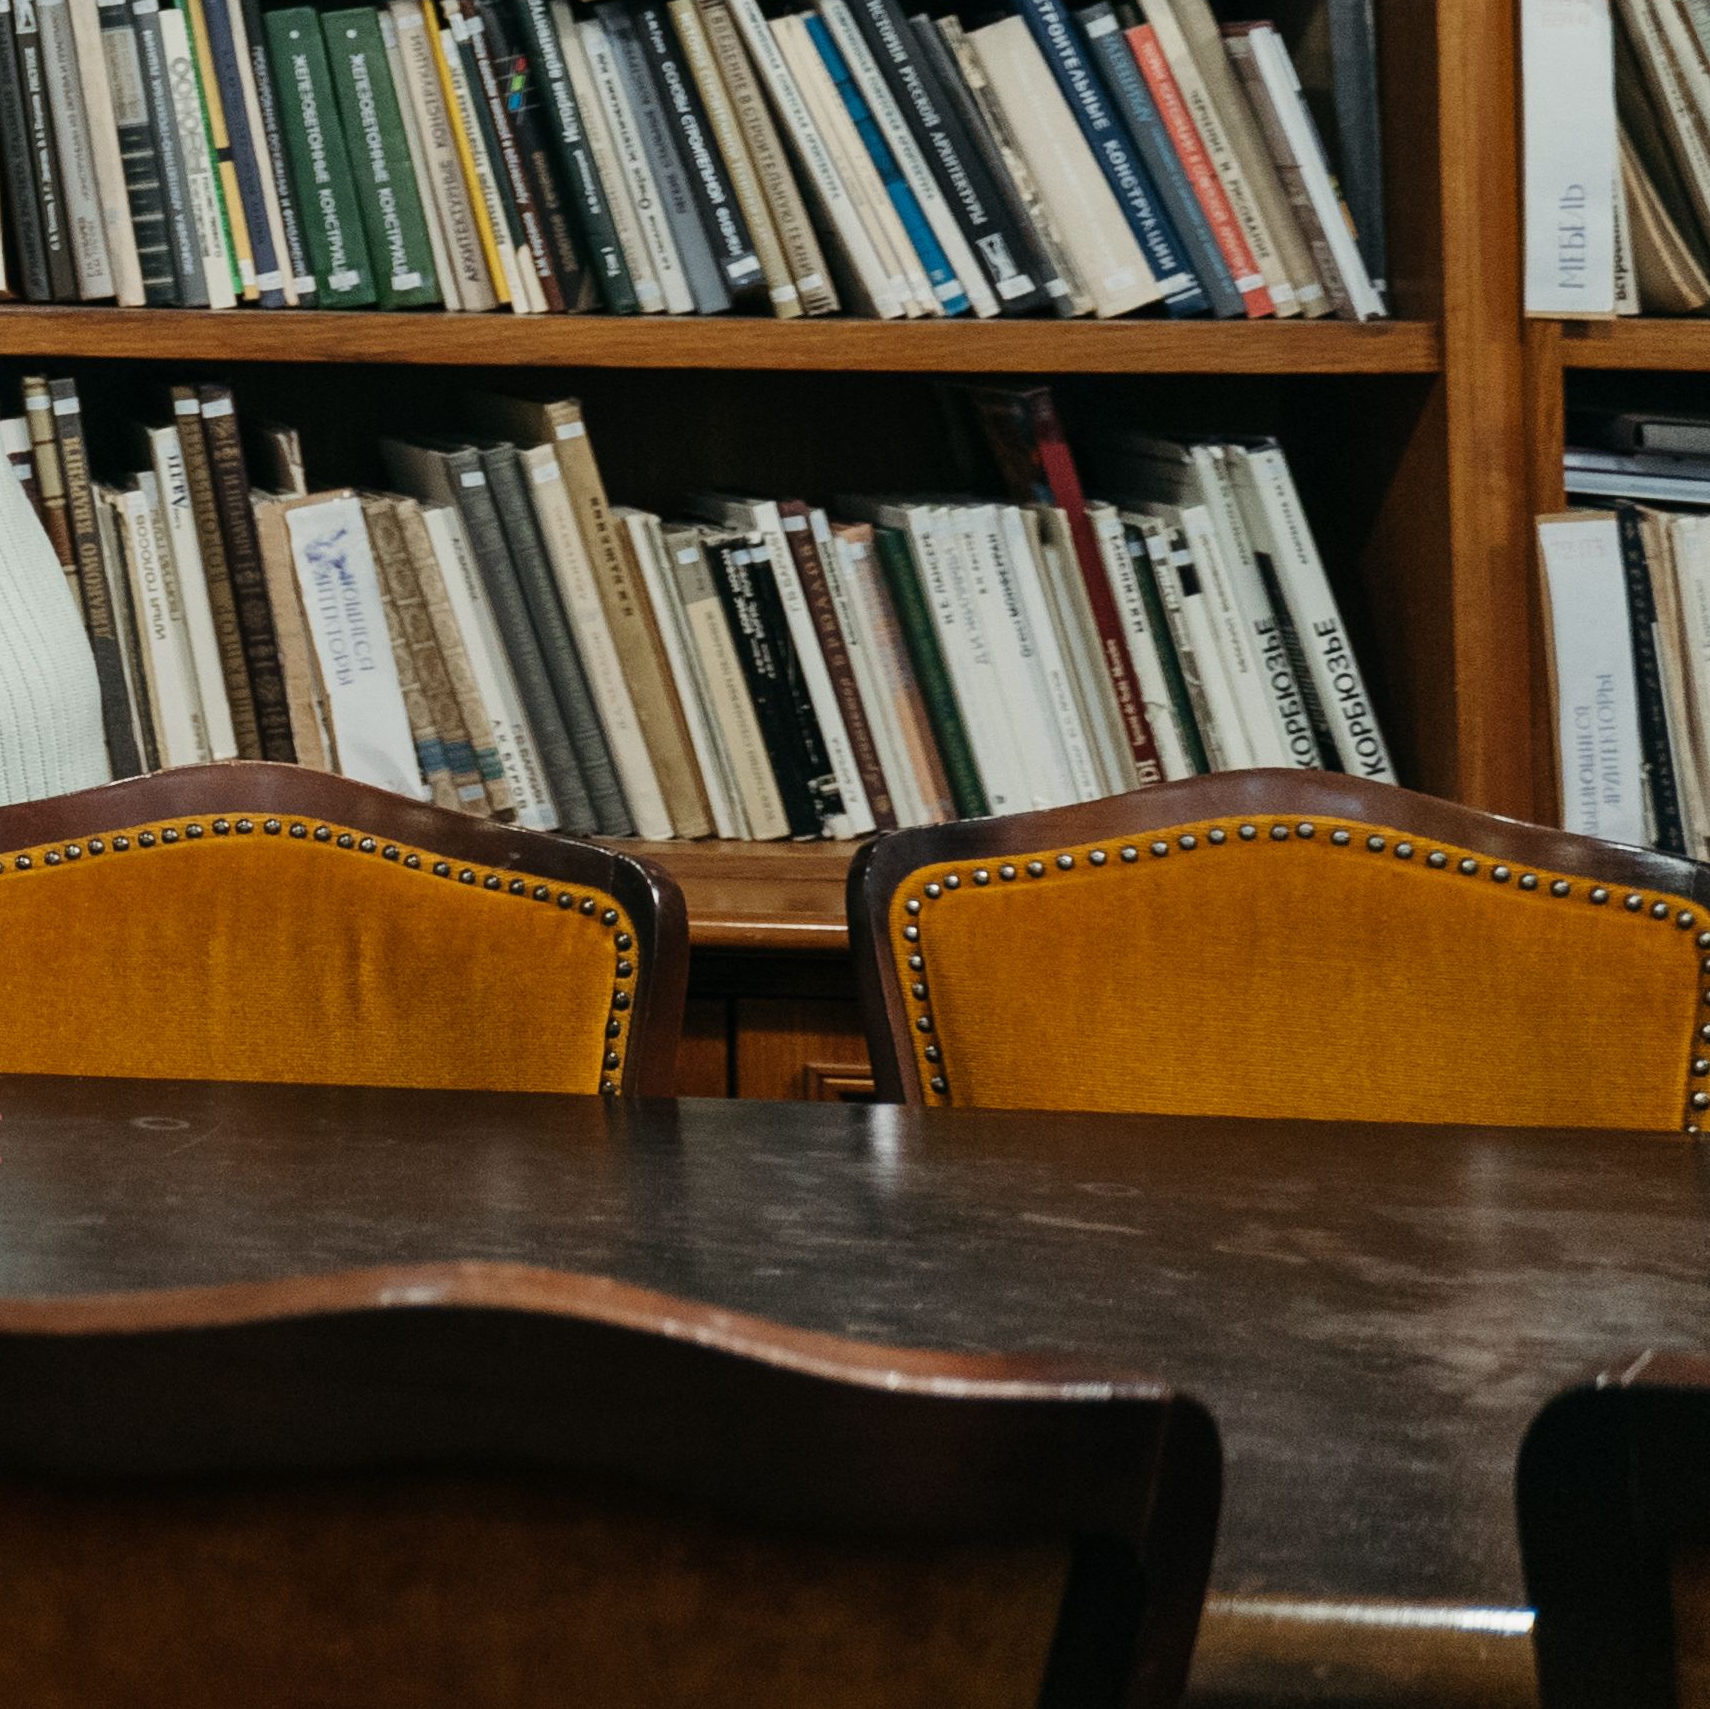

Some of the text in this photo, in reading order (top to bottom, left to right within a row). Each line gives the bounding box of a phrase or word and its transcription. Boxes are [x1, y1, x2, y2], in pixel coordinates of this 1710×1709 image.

[292, 53, 330, 185] ЖЕЛЕЗОБЕТОННЫЕ
[348, 53, 386, 183] ЖЕЛЕЗОБЕТОННЫЕ
[555, 81, 582, 144] История
[660, 61, 688, 113] ОСНОВЫ
[899, 66, 938, 128] РУССКОЙ
[409, 34, 480, 283] АРХИТЕКТУРНЫЕ КОНСТРУКЦИИ
[1102, 139, 1176, 271] КОНСТРУКЦИИ
[82, 541, 114, 640] ДЖАКОМО
[135, 514, 169, 641] ИЛЬЯ ГОЛОСОВ
[919, 530, 948, 594] ЛАНСЕРЕ
[1312, 617, 1388, 776] КОРБЮЗЬЕ
